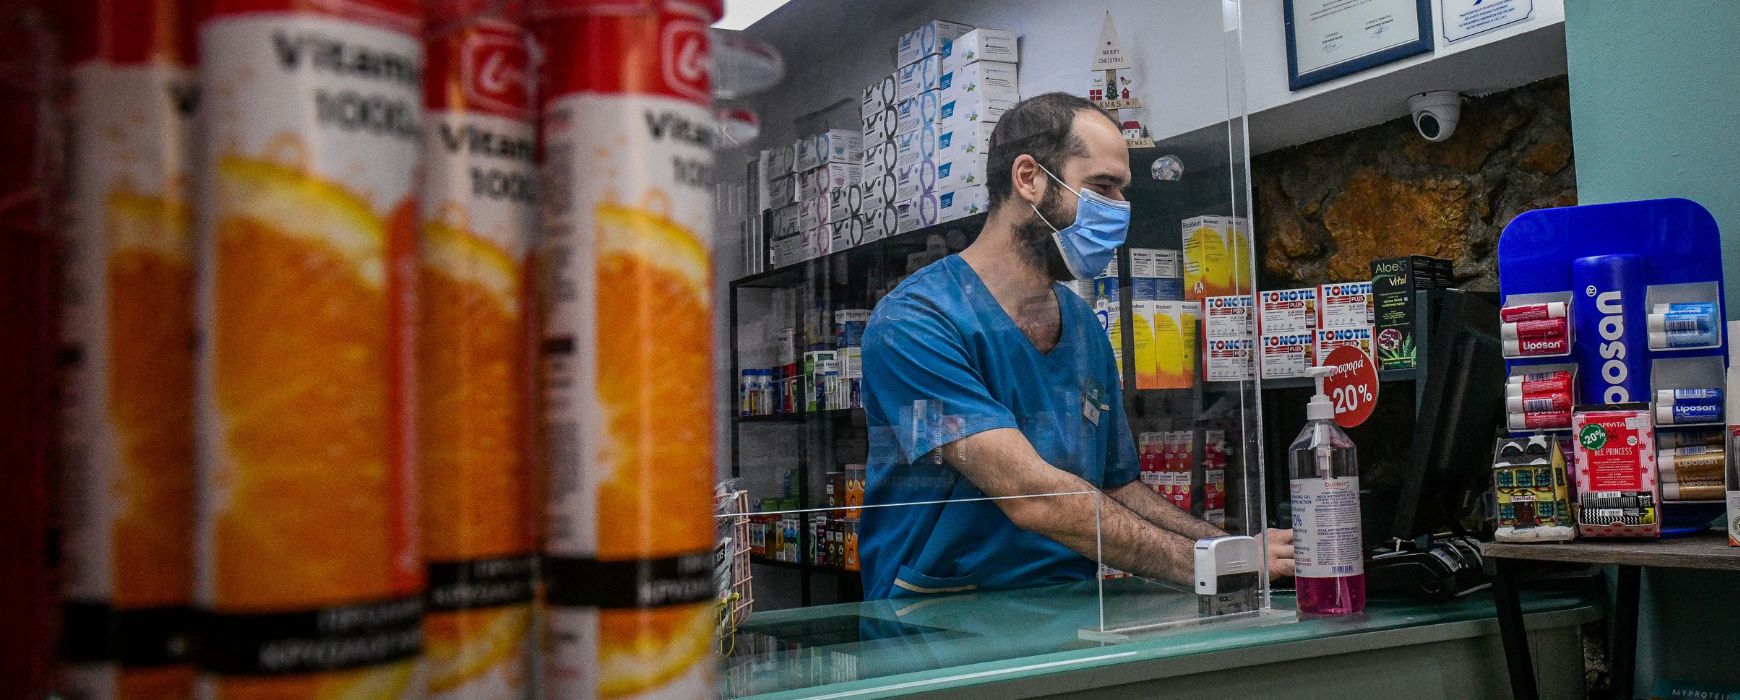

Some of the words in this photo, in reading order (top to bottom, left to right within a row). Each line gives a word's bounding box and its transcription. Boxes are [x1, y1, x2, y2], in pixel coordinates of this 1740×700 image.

[1126, 139, 1148, 148] STMAS
[1389, 273, 1407, 287] Vital
[1263, 290, 1315, 302] TONOTIL
[1319, 329, 1370, 341] TONOTIL
[1523, 340, 1561, 351] Liposan
[1596, 290, 1629, 405] posan
[1330, 355, 1364, 381] σφορά
[1333, 384, 1372, 414] 20%
[1676, 404, 1717, 414] Liposan
[1583, 430, 1606, 445] -20%
[1605, 447, 1633, 456] PRINCESS
[1679, 458, 1719, 468] Liposan
